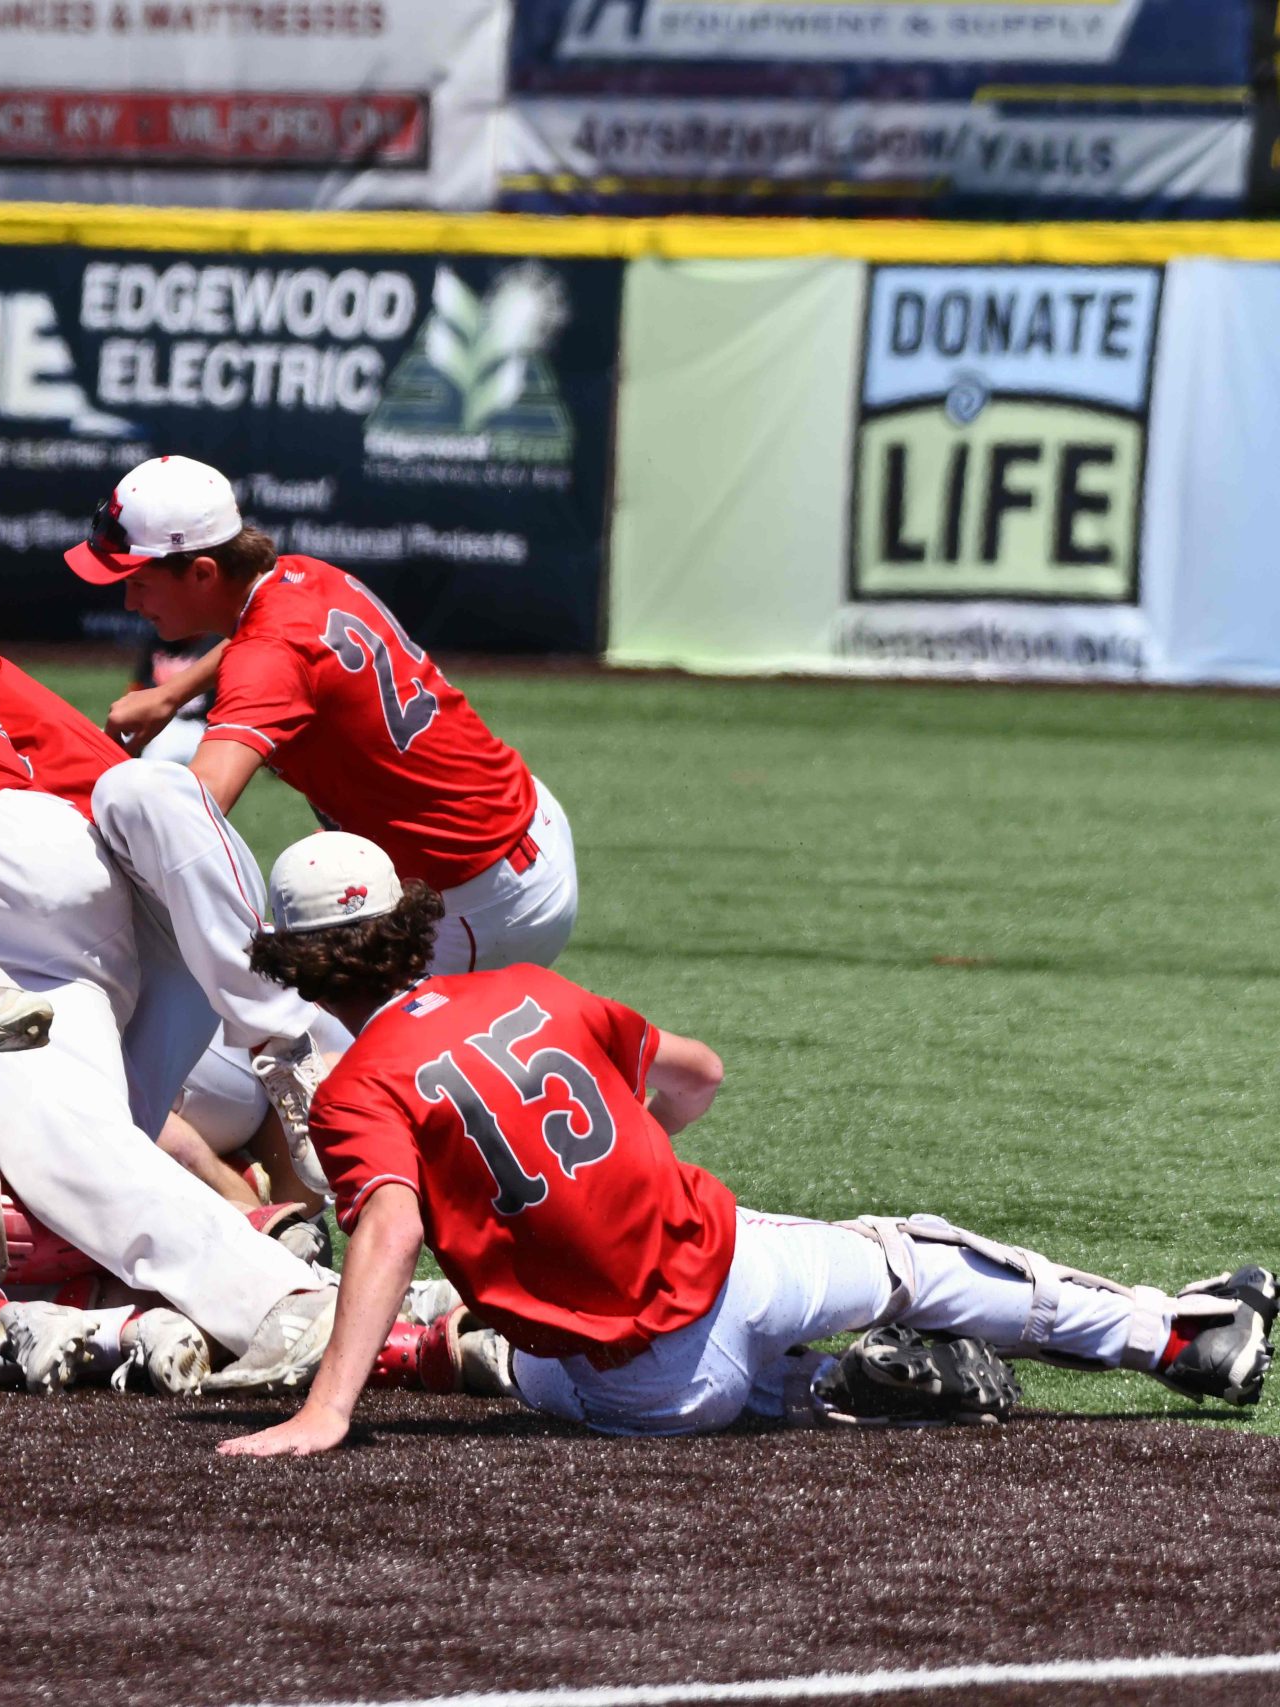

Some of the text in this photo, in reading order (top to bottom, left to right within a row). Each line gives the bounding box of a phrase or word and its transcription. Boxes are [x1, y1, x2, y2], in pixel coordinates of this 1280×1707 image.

[80, 261, 417, 341] EDGEWOOD
[888, 290, 1136, 359] DONATE
[97, 337, 385, 414] ELECTRIC
[879, 442, 1116, 567] LIFE
[414, 994, 618, 1217] 15
